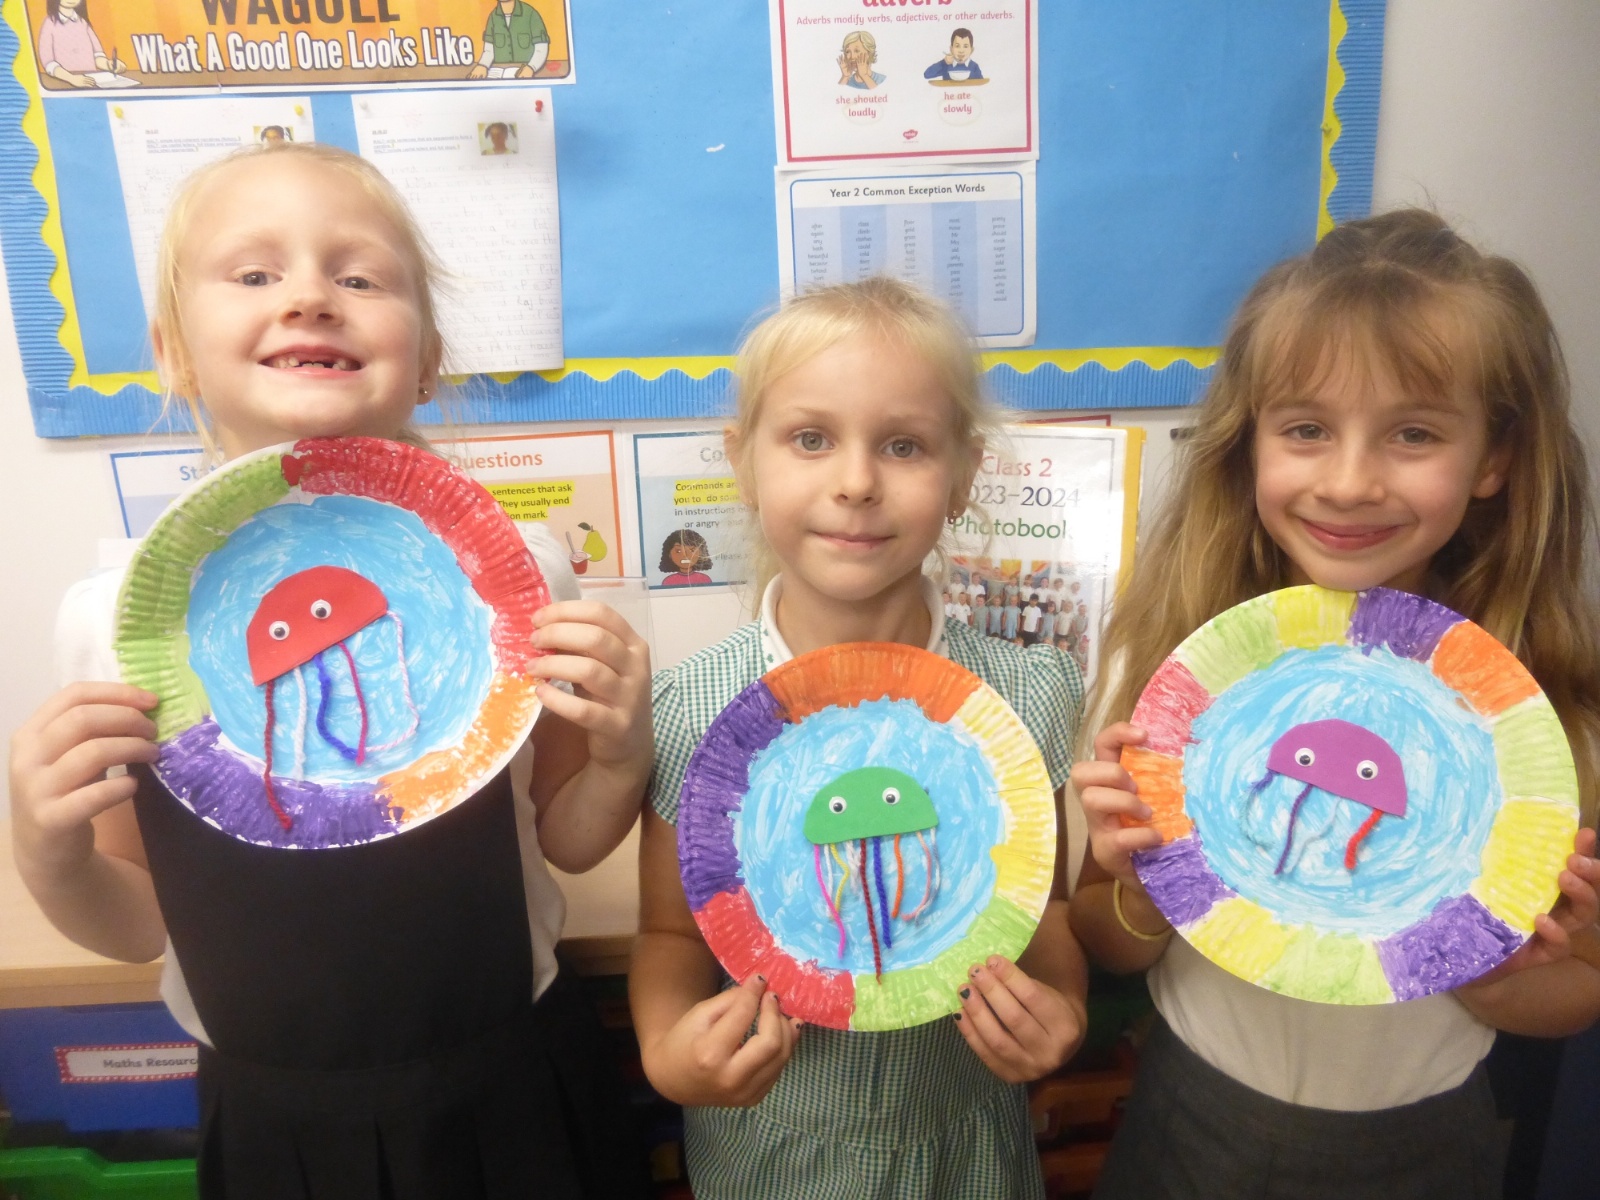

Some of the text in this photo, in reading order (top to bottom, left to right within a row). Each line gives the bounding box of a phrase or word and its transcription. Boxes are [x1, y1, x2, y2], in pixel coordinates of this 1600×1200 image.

[796, 11, 1015, 26] Adverbs modify verbs, adjectives, or other adverbs.
[131, 27, 474, 73] What A Good One Looks Like
[835, 94, 888, 104] she shouted
[944, 92, 971, 100] he ate
[848, 108, 877, 118] loudly
[943, 105, 972, 115] slowly
[830, 184, 985, 198] Year 2 Common Exception Words
[450, 452, 543, 470] Questions
[981, 456, 1052, 477] Class 2
[492, 484, 572, 496] sentences that ask
[676, 481, 736, 491] Commands ar
[674, 497, 689, 505] you
[707, 494, 717, 502] do
[969, 484, 1080, 508] 023-2024
[498, 496, 569, 509] They usually end
[523, 511, 548, 519] mark.
[674, 508, 683, 516] in
[685, 505, 735, 516] instructions
[695, 519, 719, 529] angry
[103, 1058, 143, 1068] Maths
